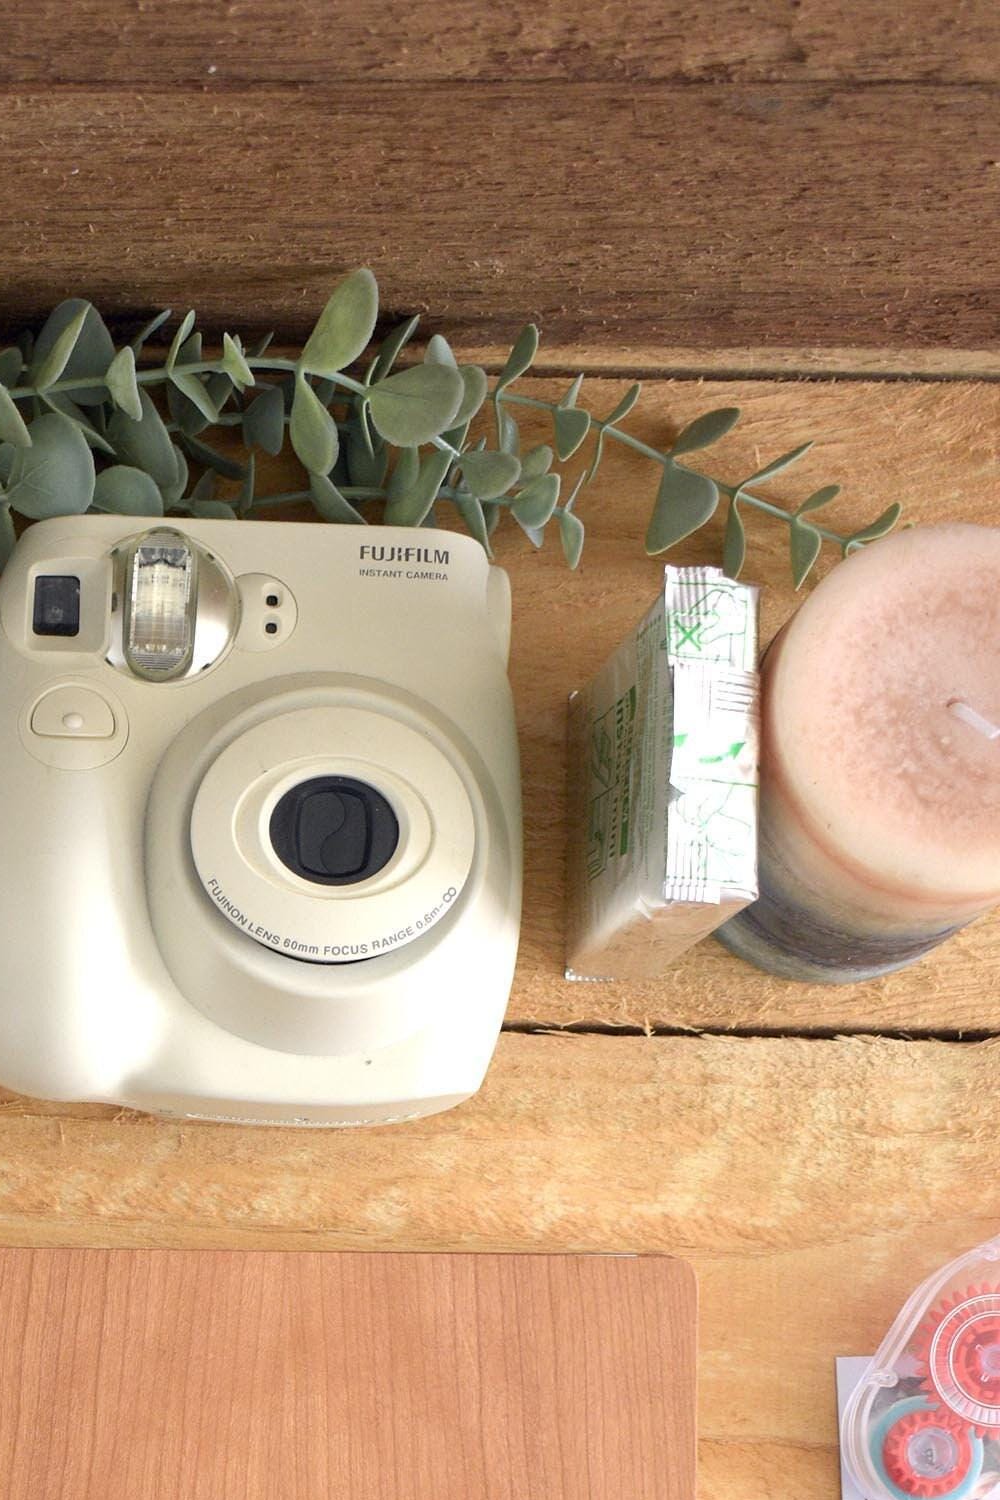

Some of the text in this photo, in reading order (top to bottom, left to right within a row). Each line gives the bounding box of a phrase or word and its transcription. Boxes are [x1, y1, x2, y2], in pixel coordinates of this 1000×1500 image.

[359, 545, 450, 565] FUJIFILM
[359, 568, 449, 581] INSTANT CAMERA
[207, 878, 248, 925] FUJINON
[247, 922, 281, 945] LENS
[283, 938, 319, 955] 60mm
[323, 943, 369, 956] FOCUS
[371, 925, 415, 951] RANGE
